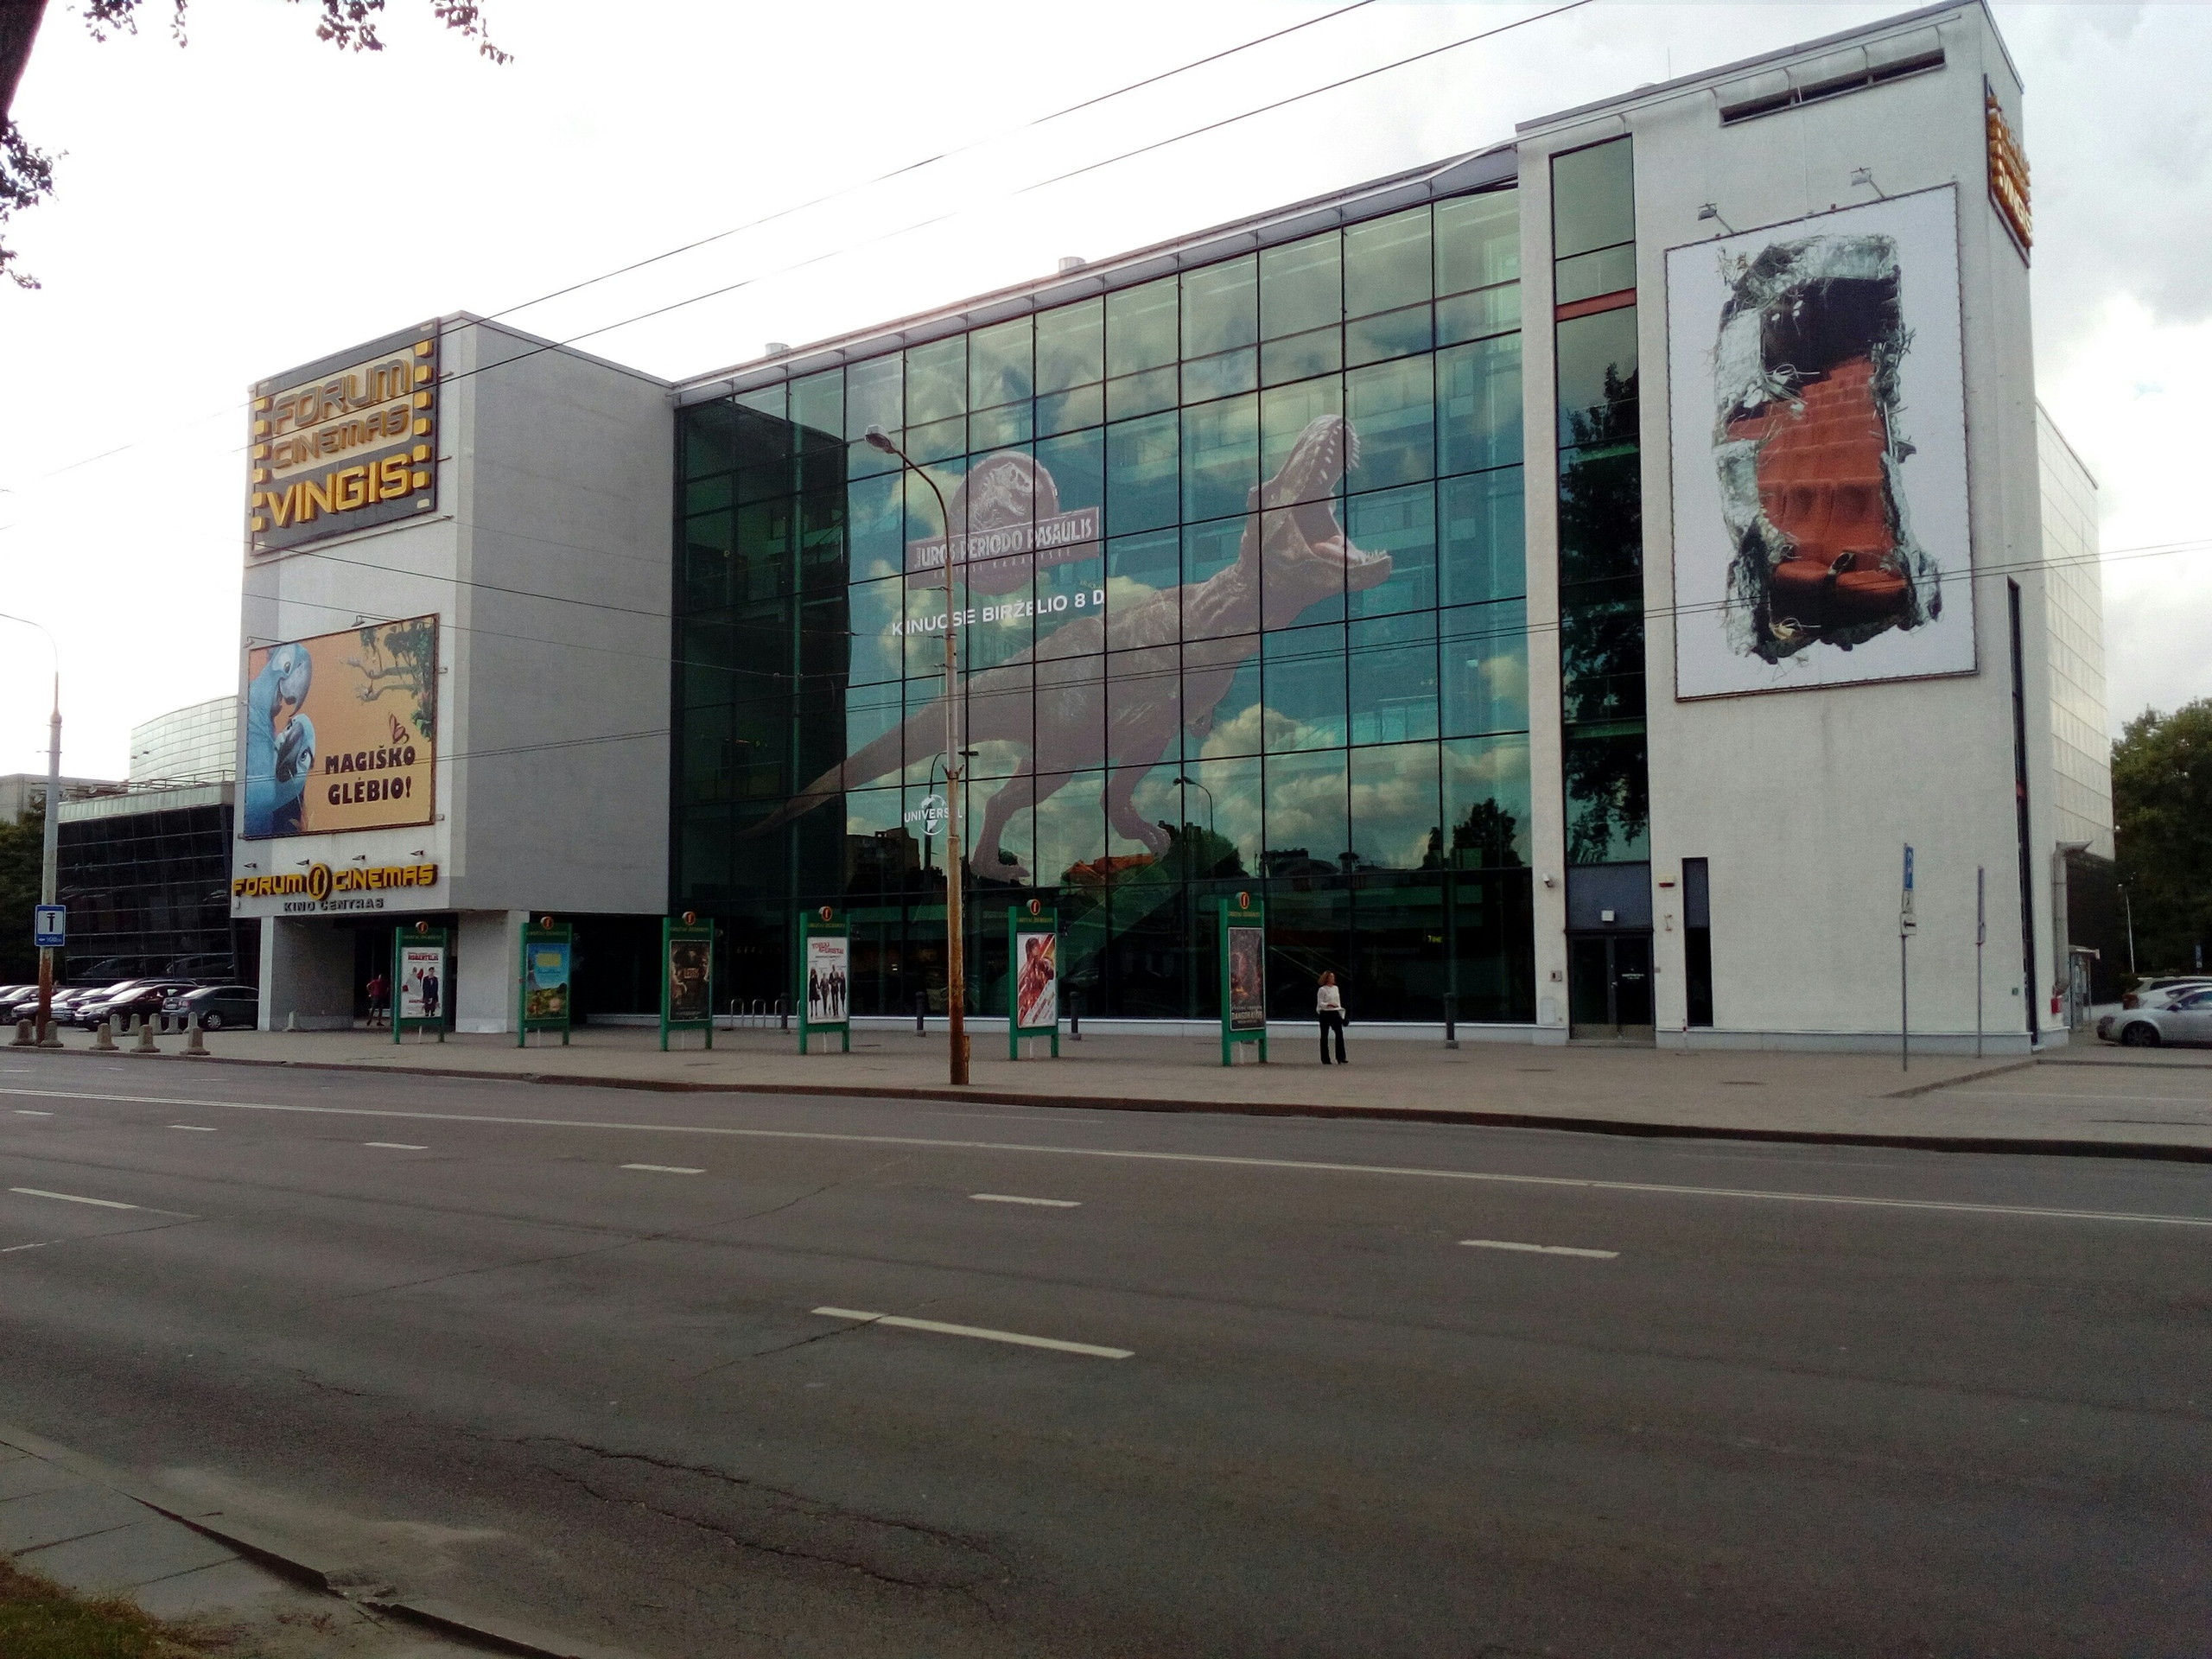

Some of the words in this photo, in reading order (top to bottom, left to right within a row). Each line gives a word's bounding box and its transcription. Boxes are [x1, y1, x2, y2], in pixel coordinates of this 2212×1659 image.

[272, 359, 410, 435] FORUM
[272, 404, 409, 469] CINEMAS
[266, 453, 413, 528] VINGIS
[960, 530, 1023, 559] PERIODO
[1027, 518, 1092, 548] PASAULIS
[983, 595, 1067, 622] BIRŽELIO
[1075, 593, 1085, 607] 8
[325, 745, 416, 775] MAGIŠKO
[327, 776, 411, 805] GLĖBIO!
[905, 806, 963, 823] UNIVERSL
[232, 874, 307, 896] FORUM
[333, 863, 437, 891] CINEMAS
[283, 901, 315, 912] KINO
[321, 898, 384, 911] CENTRAS
